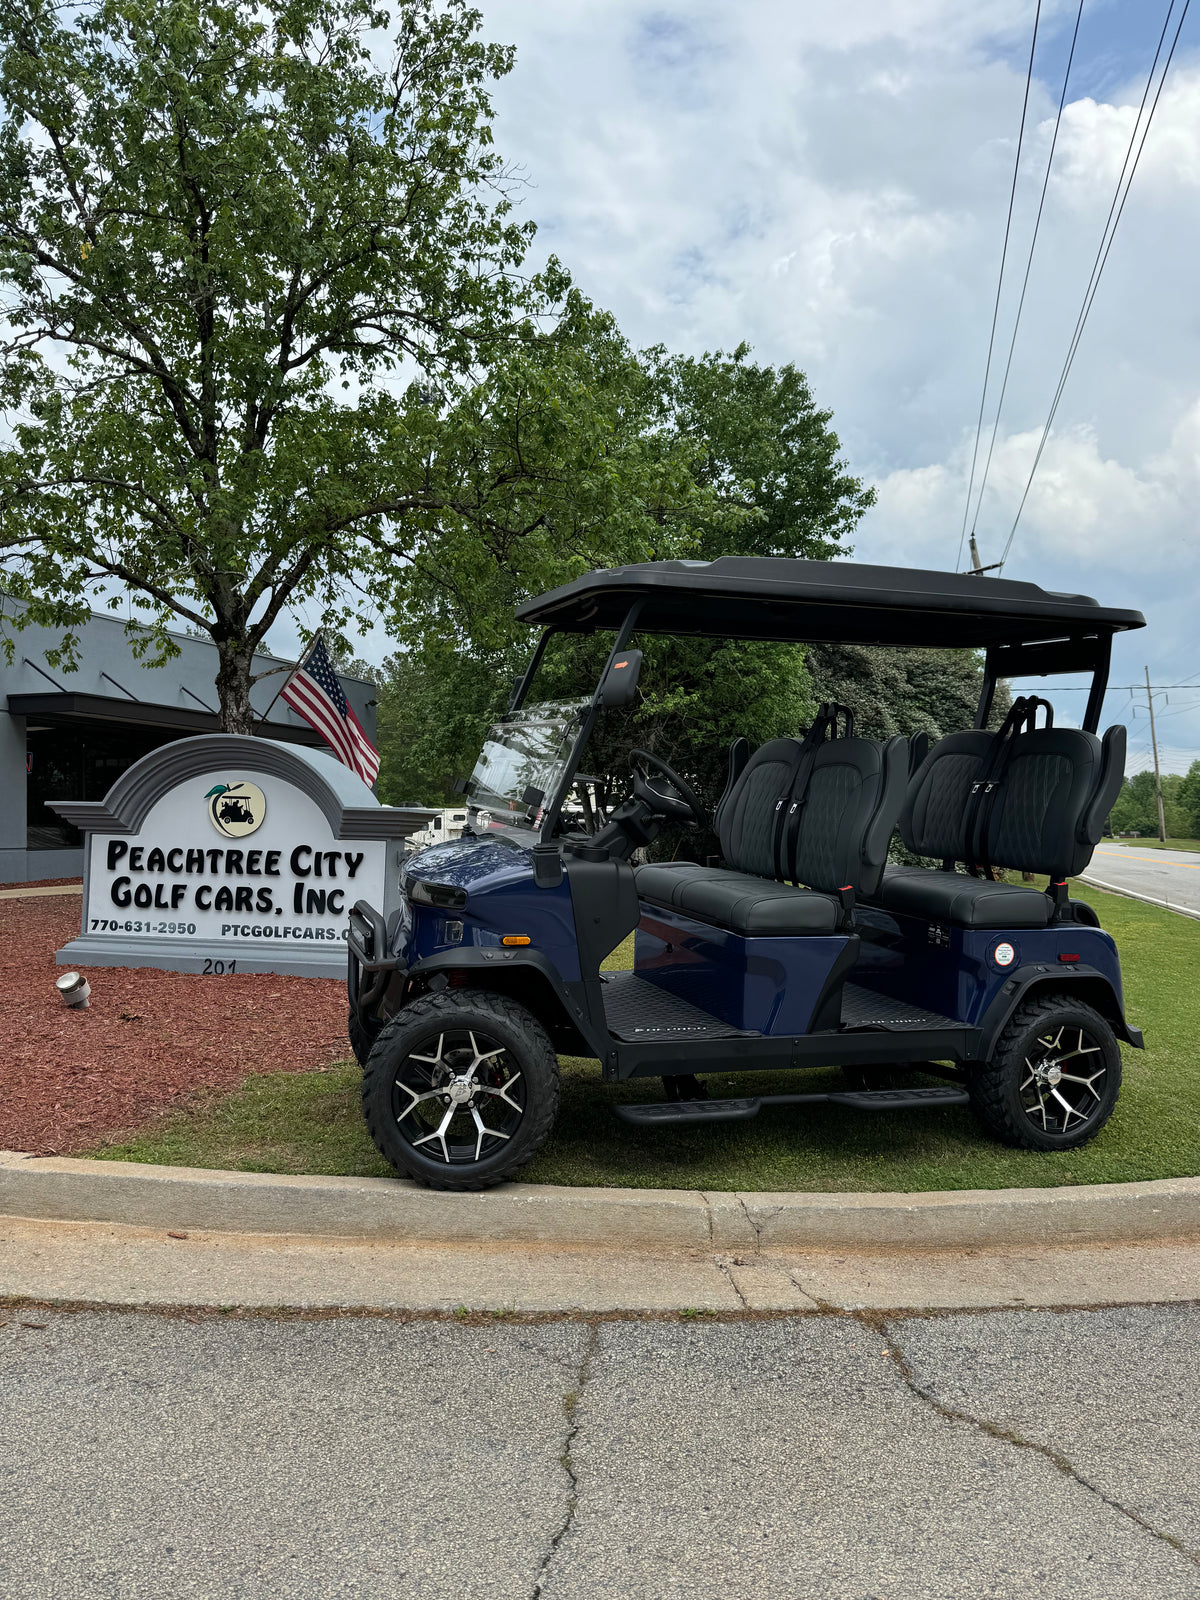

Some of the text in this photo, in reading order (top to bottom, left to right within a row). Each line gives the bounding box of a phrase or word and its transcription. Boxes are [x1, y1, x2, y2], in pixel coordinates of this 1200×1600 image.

[107, 839, 365, 878] PEACHTREE CITY
[110, 875, 188, 911] GOLF
[194, 884, 283, 915] CARS,
[91, 919, 197, 935] 770-631-2950
[202, 958, 238, 975] 201
